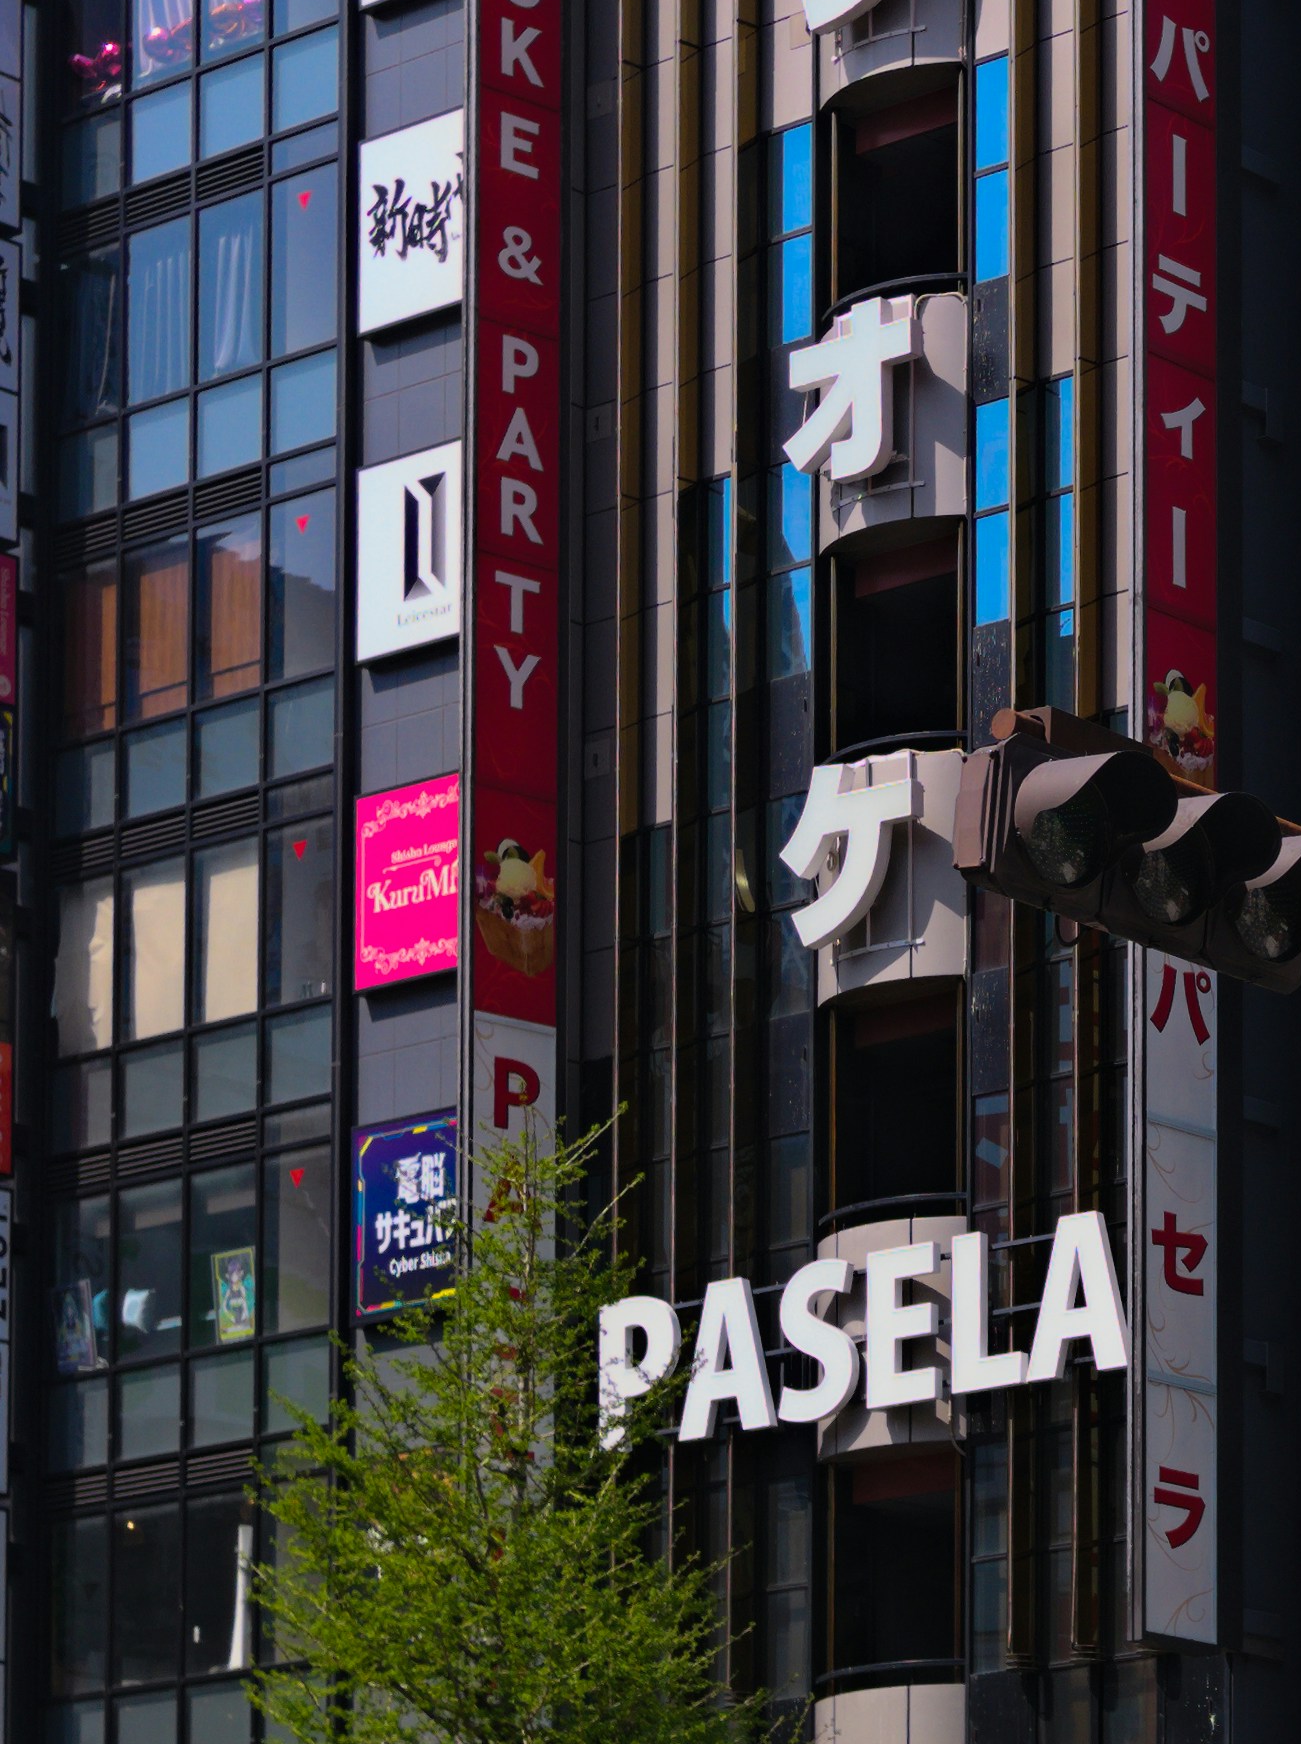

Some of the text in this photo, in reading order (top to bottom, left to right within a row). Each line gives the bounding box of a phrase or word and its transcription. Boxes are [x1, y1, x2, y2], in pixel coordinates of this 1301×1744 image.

[369, 156, 464, 263] 新時
[496, 223, 545, 287] &
[494, 334, 546, 713] PARTY
[599, 1210, 1129, 1453] PASELA
